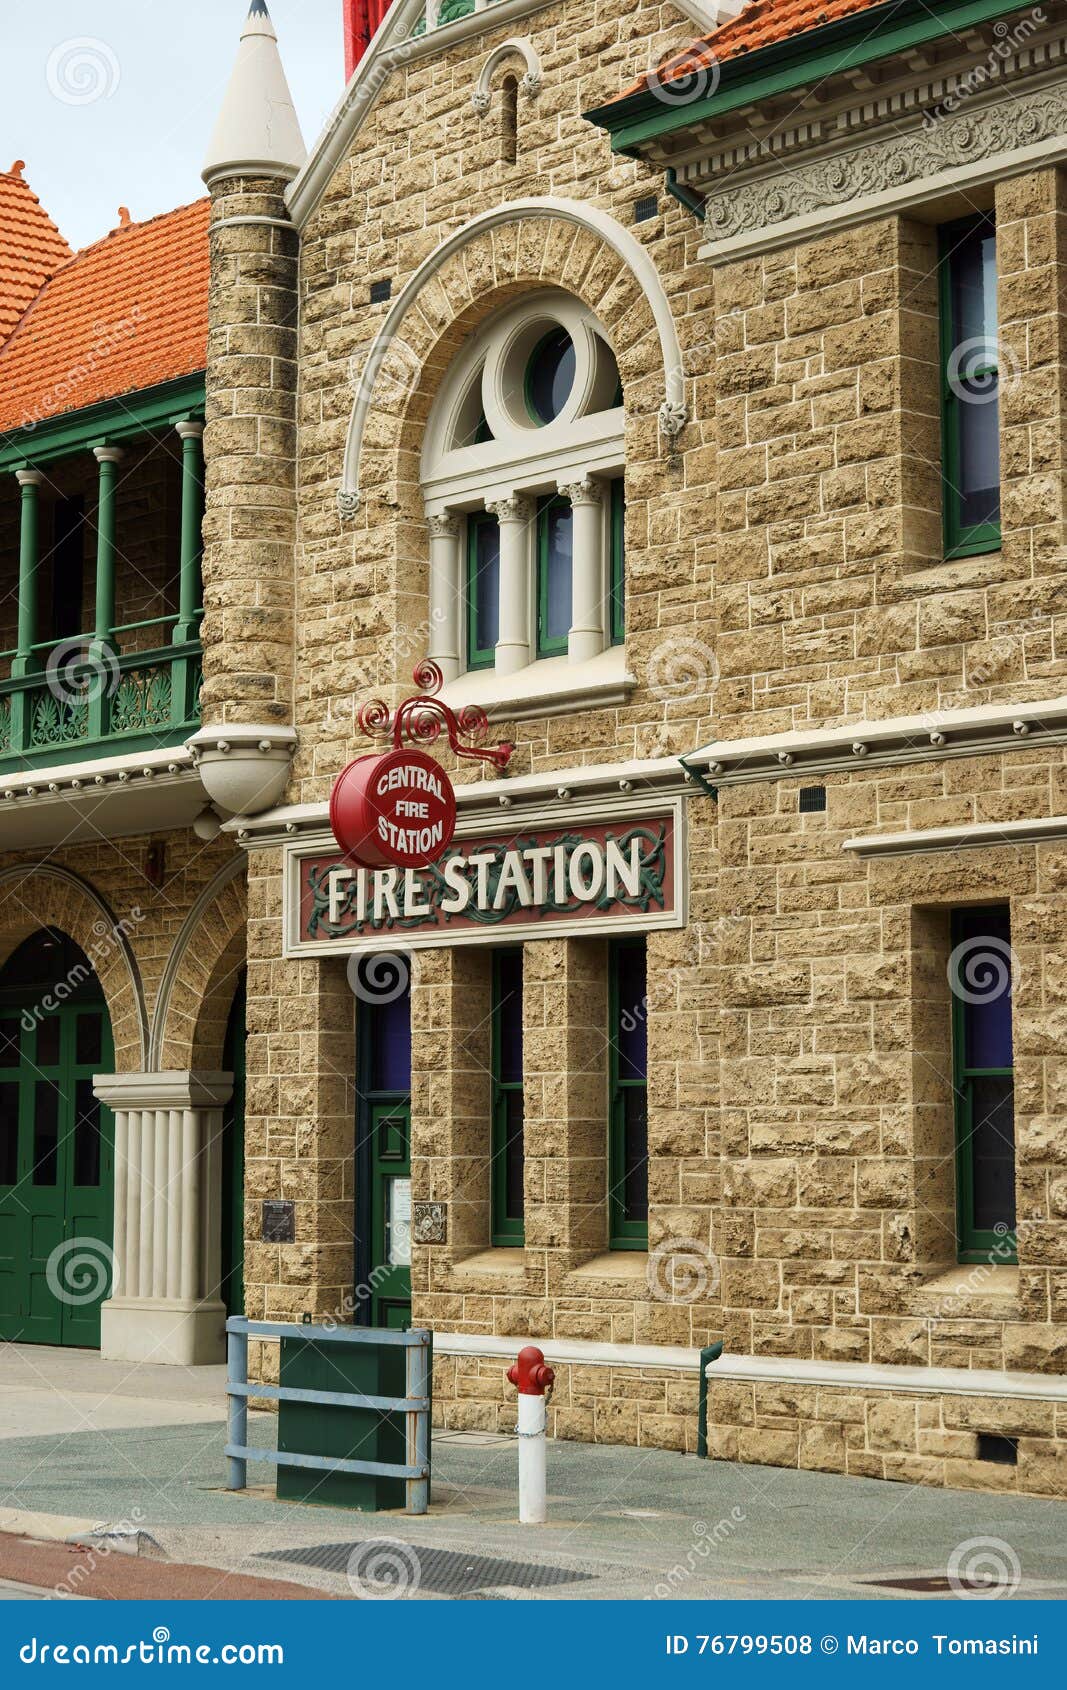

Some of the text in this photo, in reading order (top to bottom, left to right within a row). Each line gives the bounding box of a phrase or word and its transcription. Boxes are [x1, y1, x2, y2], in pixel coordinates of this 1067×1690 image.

[377, 765, 446, 804] CENTRAL
[395, 800, 429, 819] FIRE
[378, 815, 443, 854] STATION
[328, 838, 643, 924] FIRE STATION
